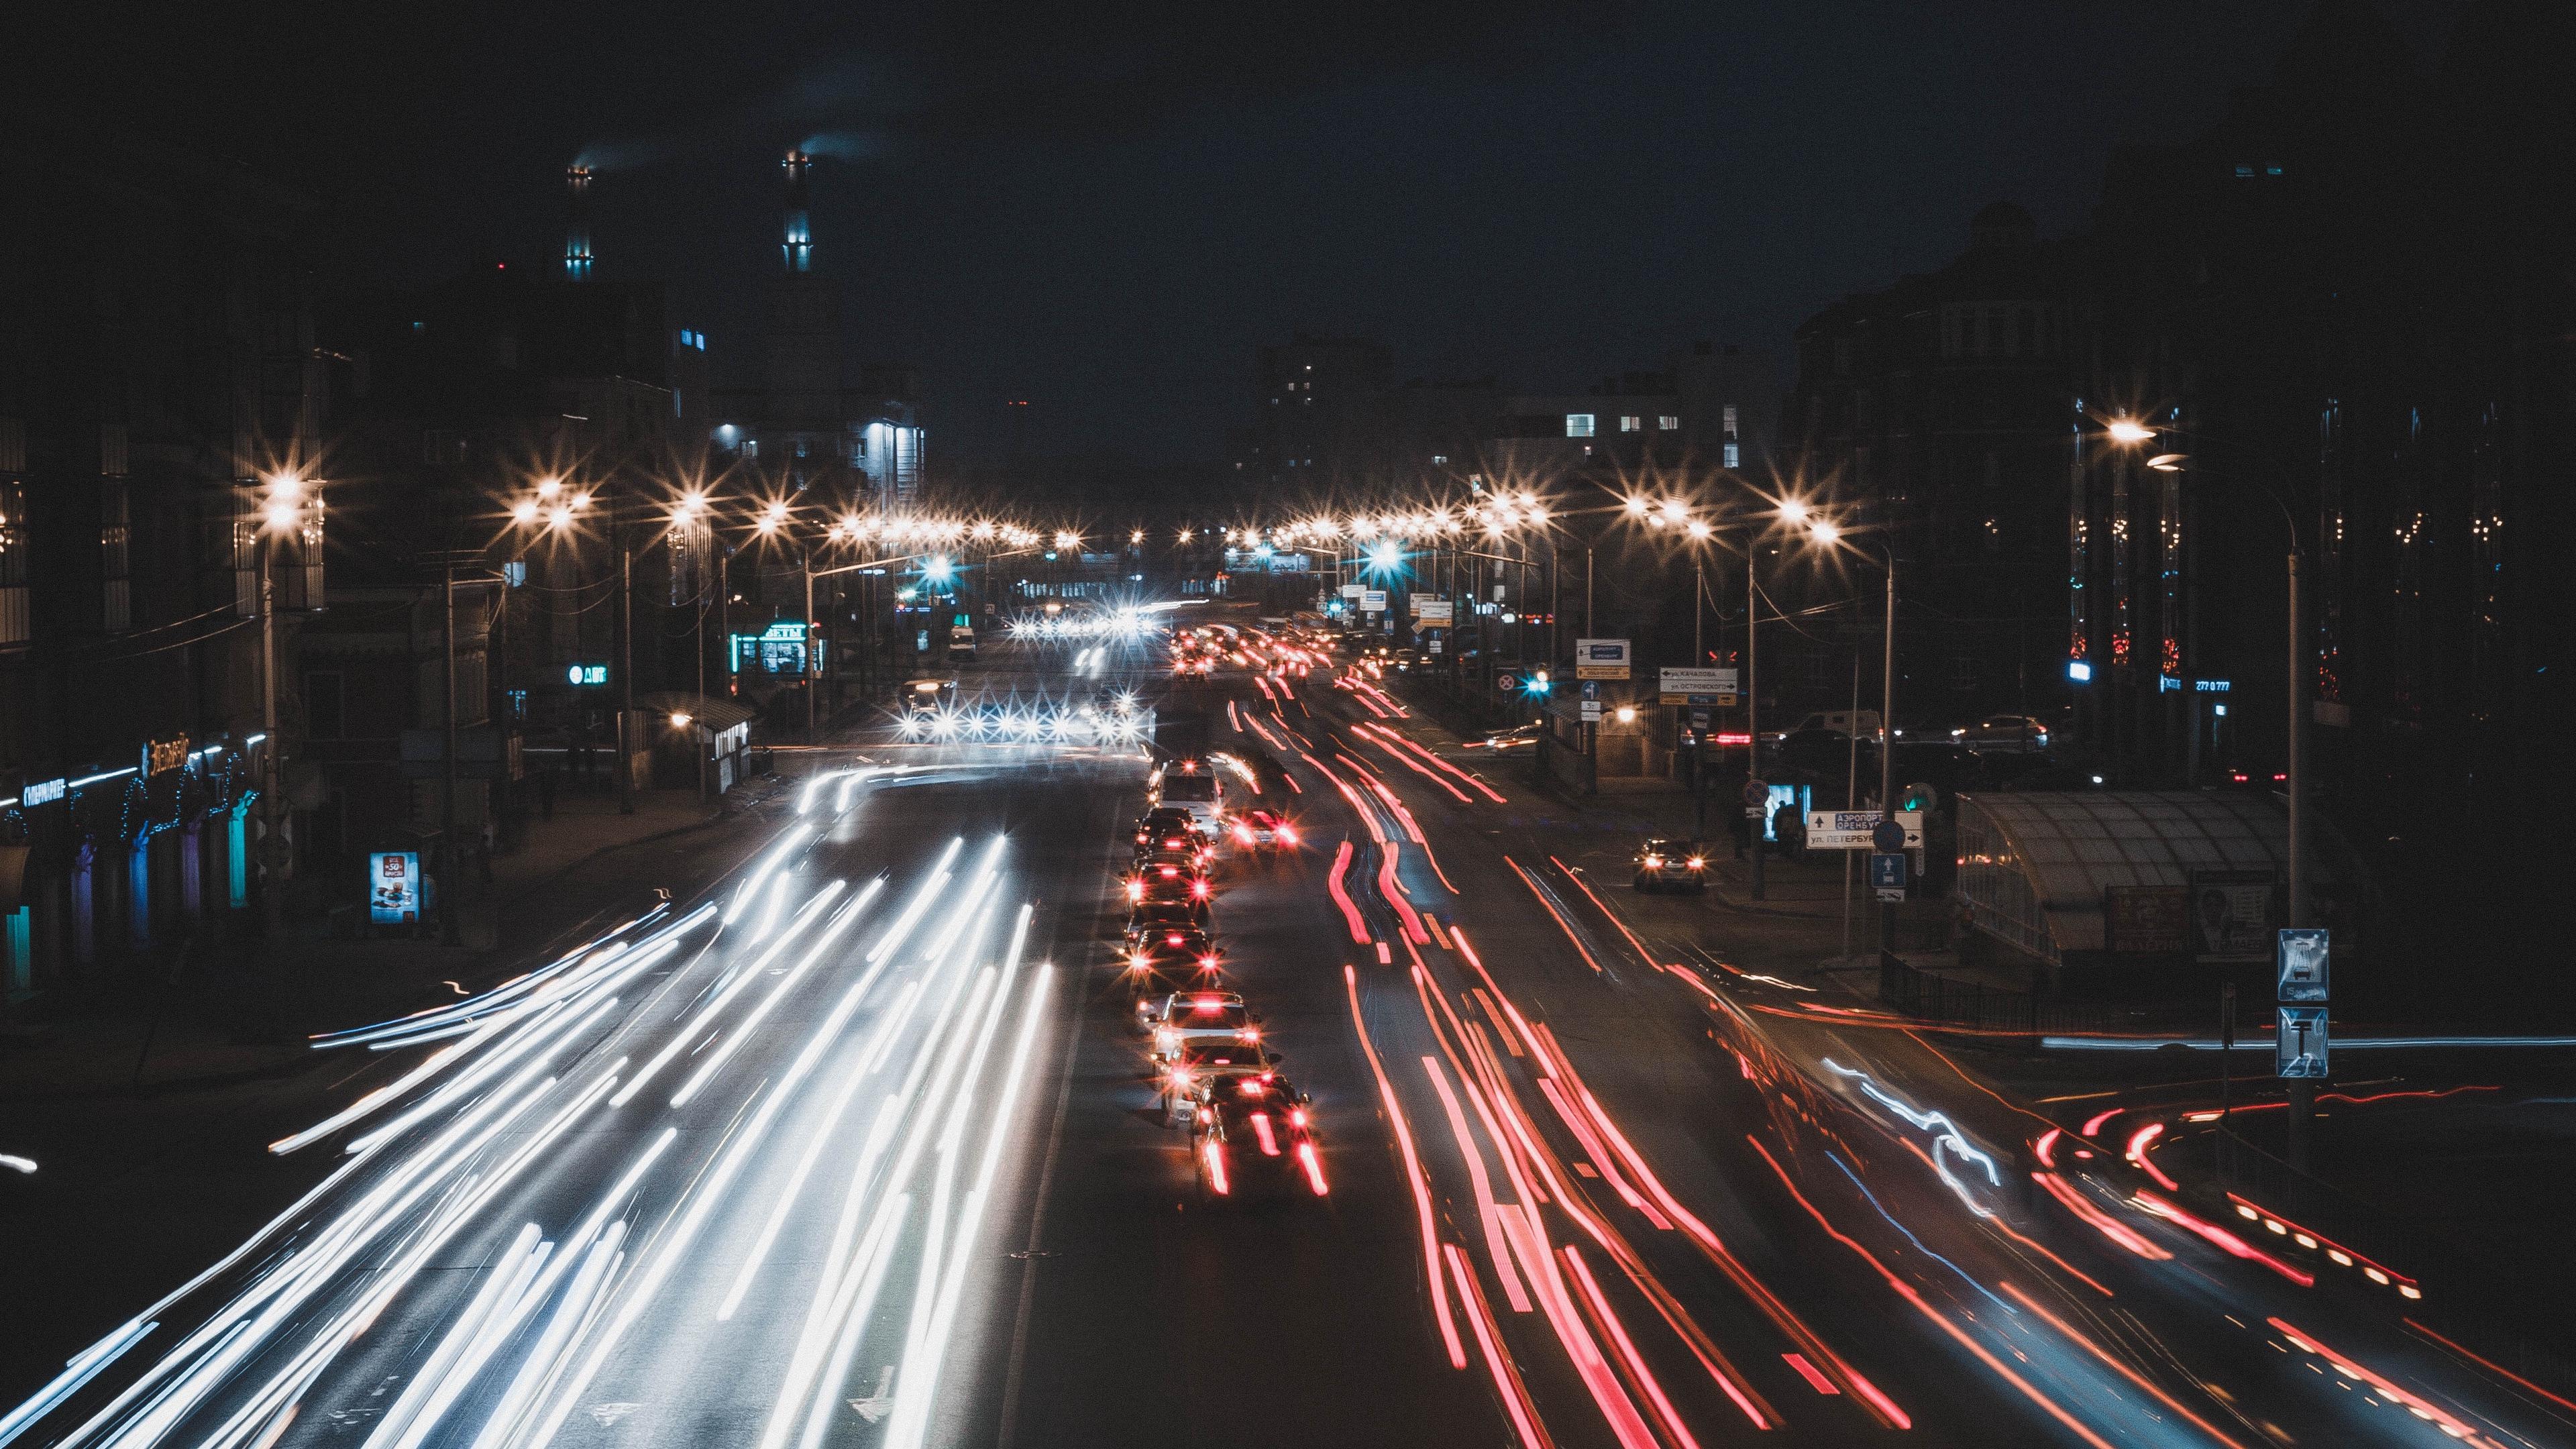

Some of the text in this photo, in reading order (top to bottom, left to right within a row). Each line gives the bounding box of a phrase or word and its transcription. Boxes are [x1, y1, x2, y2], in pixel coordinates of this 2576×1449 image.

[1837, 814, 1884, 822] АЭРОПОРТ
[1837, 822, 1880, 830] ОРЕНБУ
[1811, 836, 1824, 844] ул.
